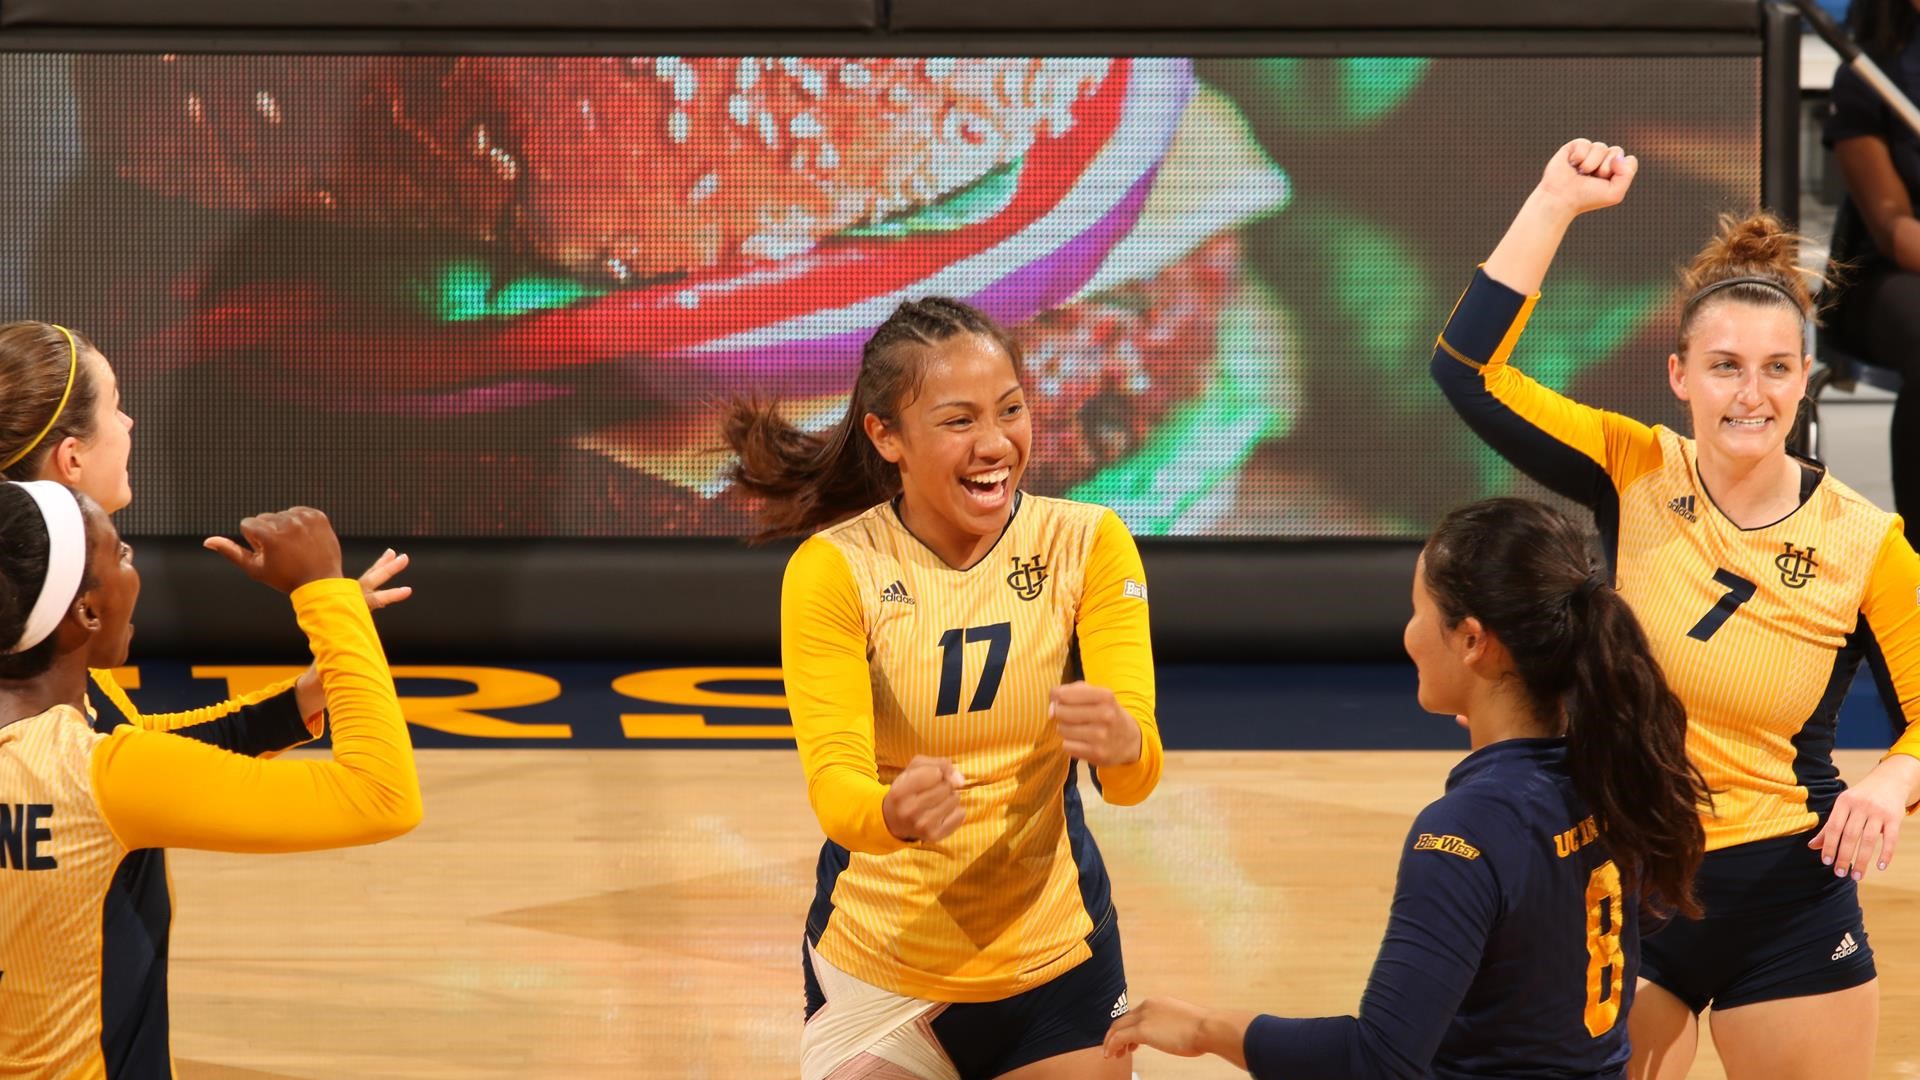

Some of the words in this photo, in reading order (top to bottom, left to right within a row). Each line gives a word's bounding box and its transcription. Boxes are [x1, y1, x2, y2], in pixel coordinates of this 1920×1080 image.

[1667, 500, 1697, 523] adidas
[880, 592, 915, 605] adidas
[1686, 567, 1757, 642] 7
[935, 621, 1012, 717] 17
[0, 803, 58, 871] NE
[1584, 860, 1624, 1038] 8
[1831, 943, 1859, 961] adidas
